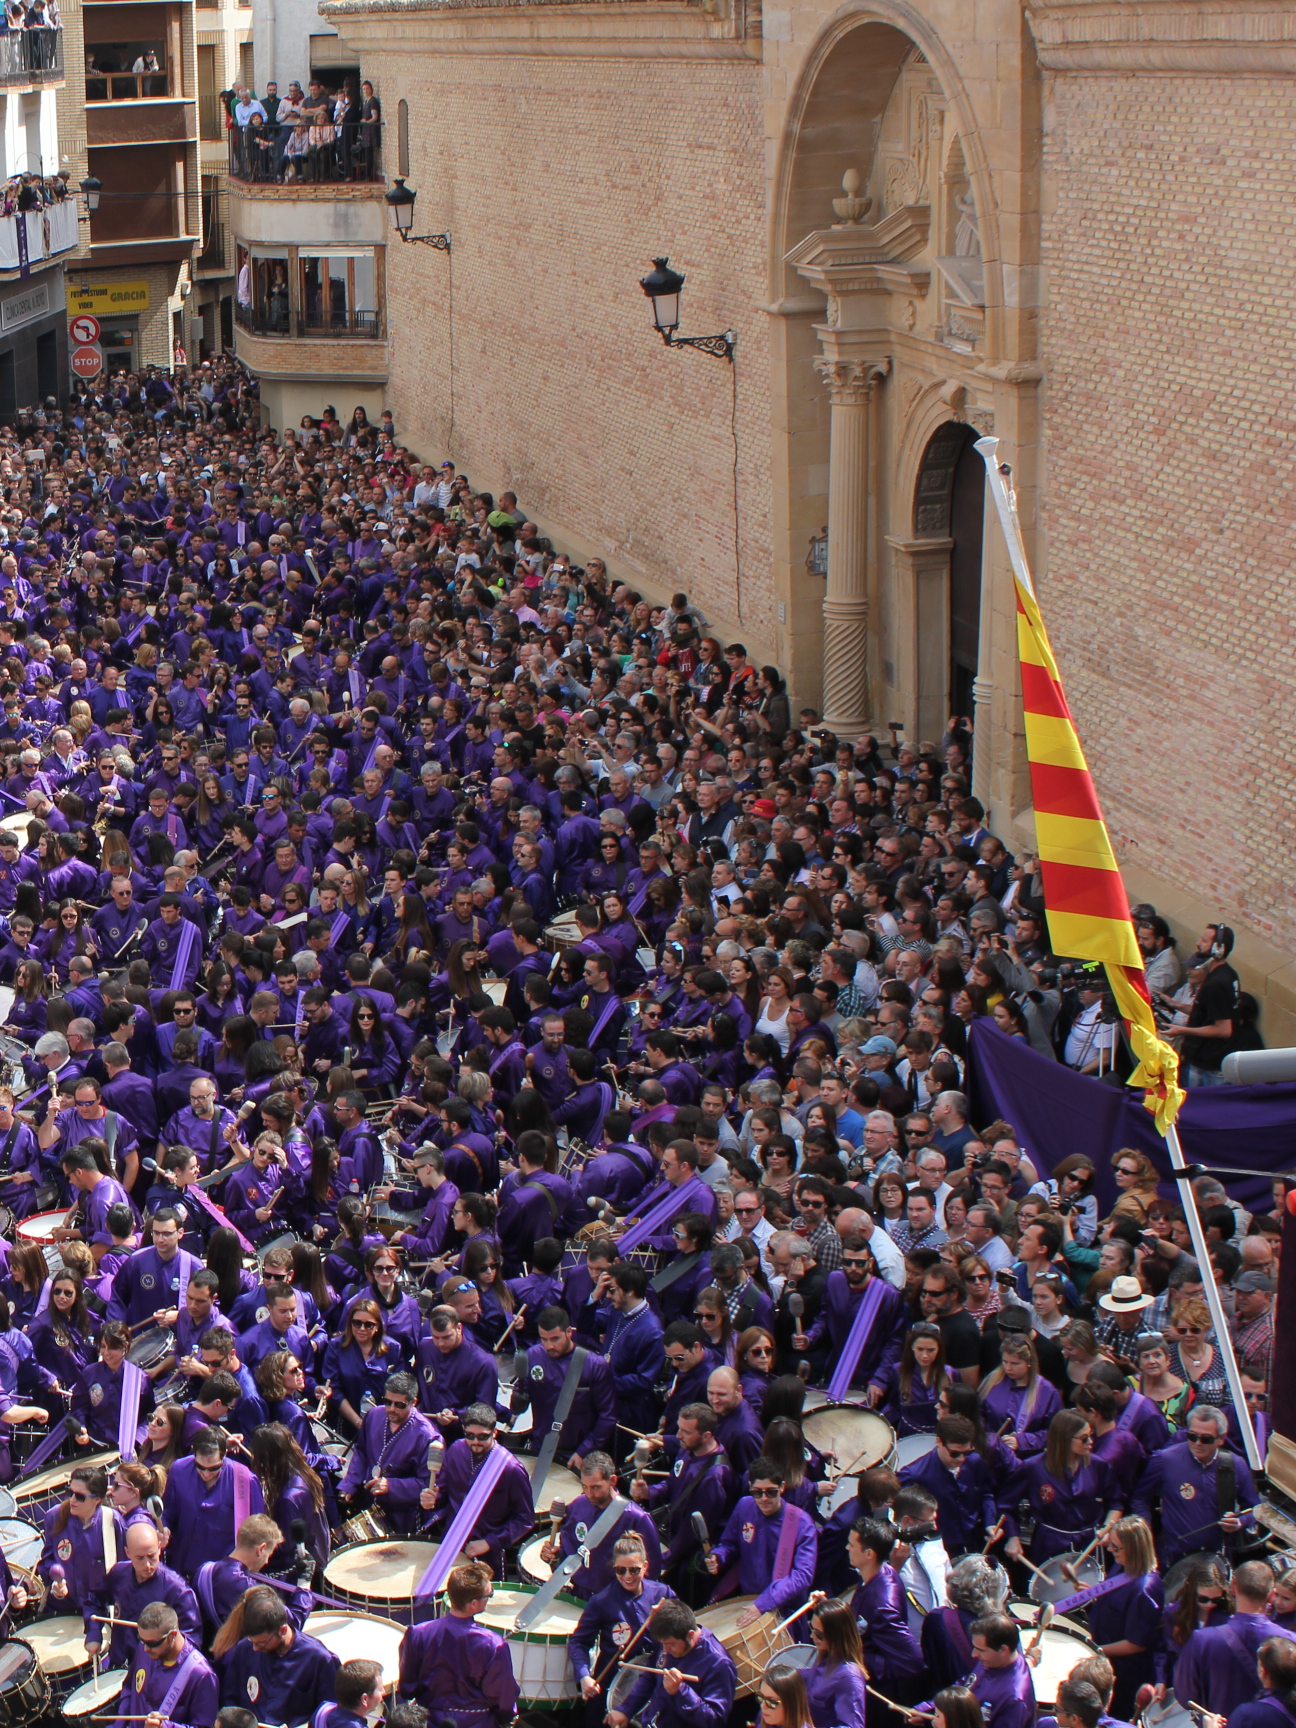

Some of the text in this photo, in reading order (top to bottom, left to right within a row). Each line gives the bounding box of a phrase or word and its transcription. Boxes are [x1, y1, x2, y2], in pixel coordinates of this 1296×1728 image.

[110, 290, 147, 302] GRACIA
[78, 301, 93, 309] VIDEO
[74, 358, 99, 366] STOP
